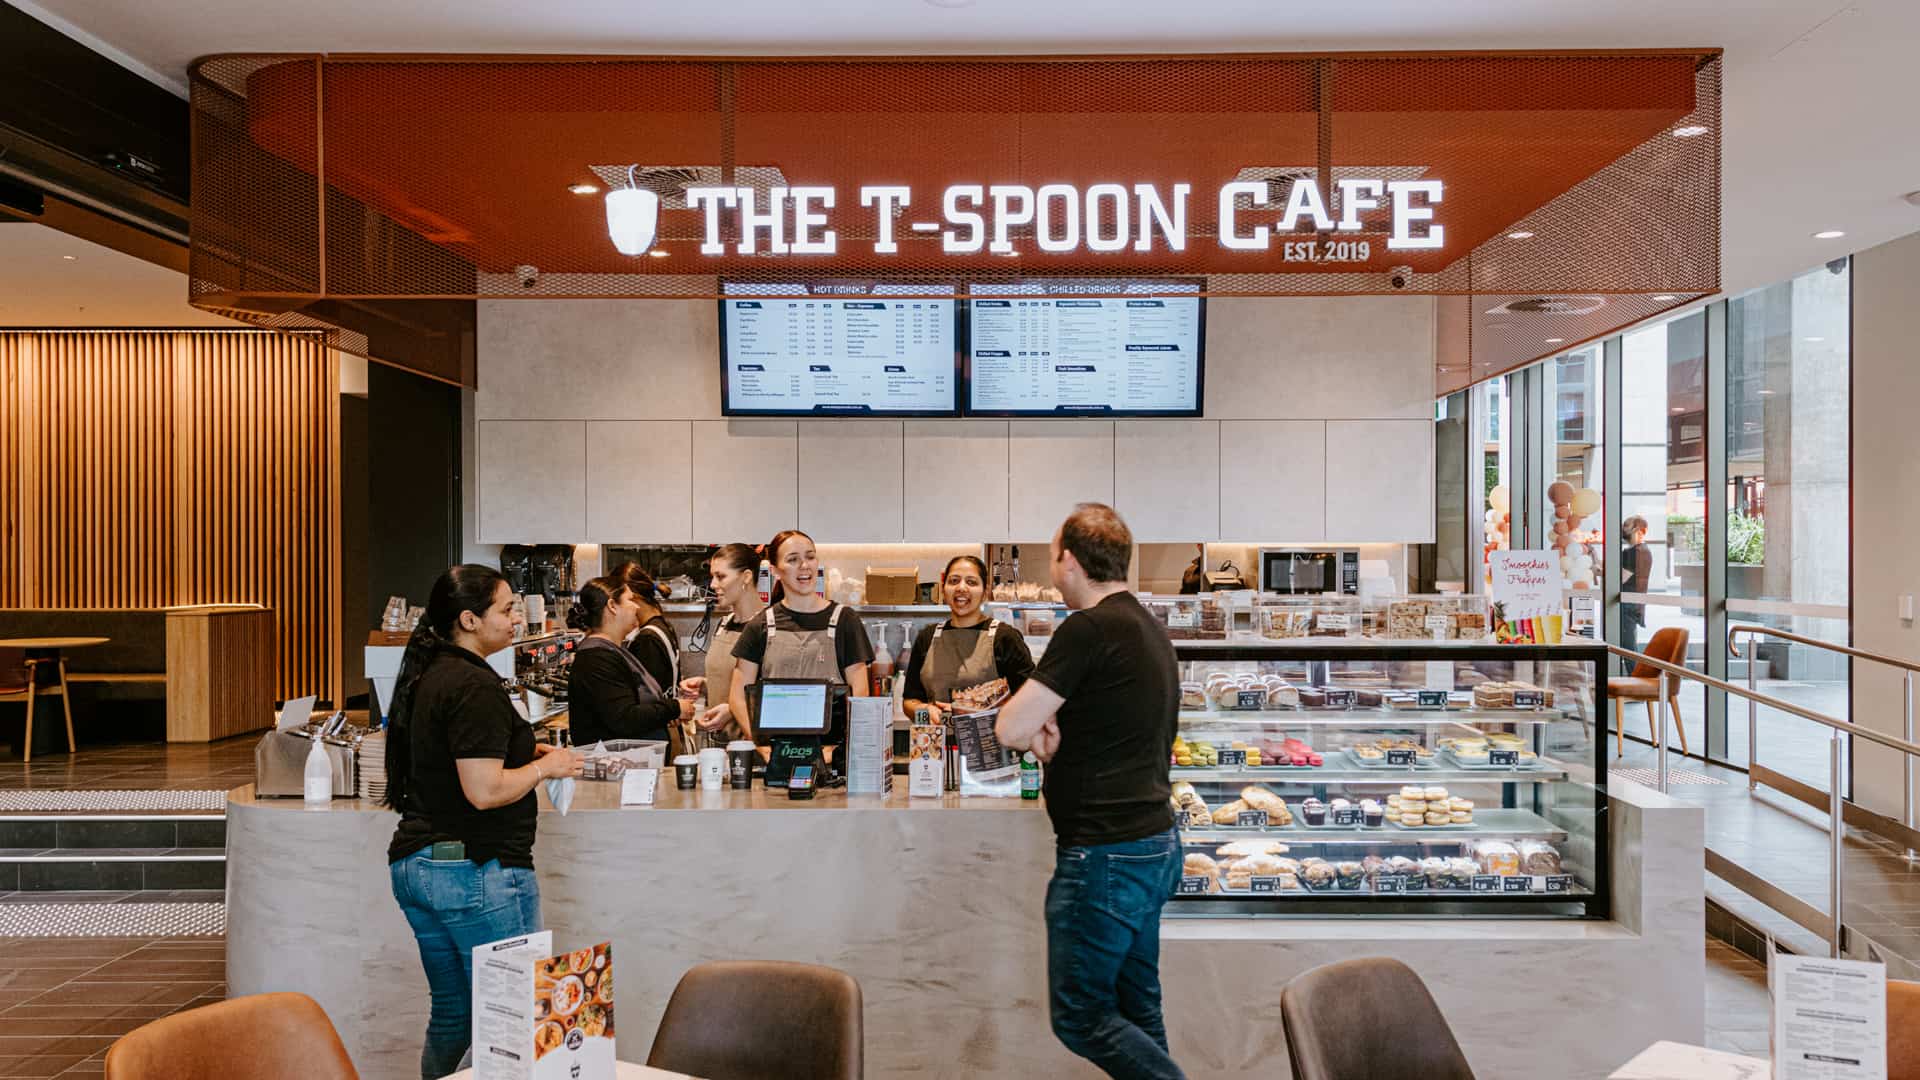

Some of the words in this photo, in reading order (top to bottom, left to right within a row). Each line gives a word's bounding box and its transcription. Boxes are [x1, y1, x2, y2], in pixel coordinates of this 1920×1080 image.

[687, 187, 836, 254] THE
[861, 184, 1191, 254] T-SPOON
[1220, 179, 1444, 249] CAFE
[1326, 242, 1370, 261] 2019
[814, 285, 832, 294] HOT
[836, 285, 866, 294] DRINKS
[1049, 285, 1085, 294] CHILLED
[1087, 285, 1120, 294] DRINKS
[917, 711, 928, 722] 18
